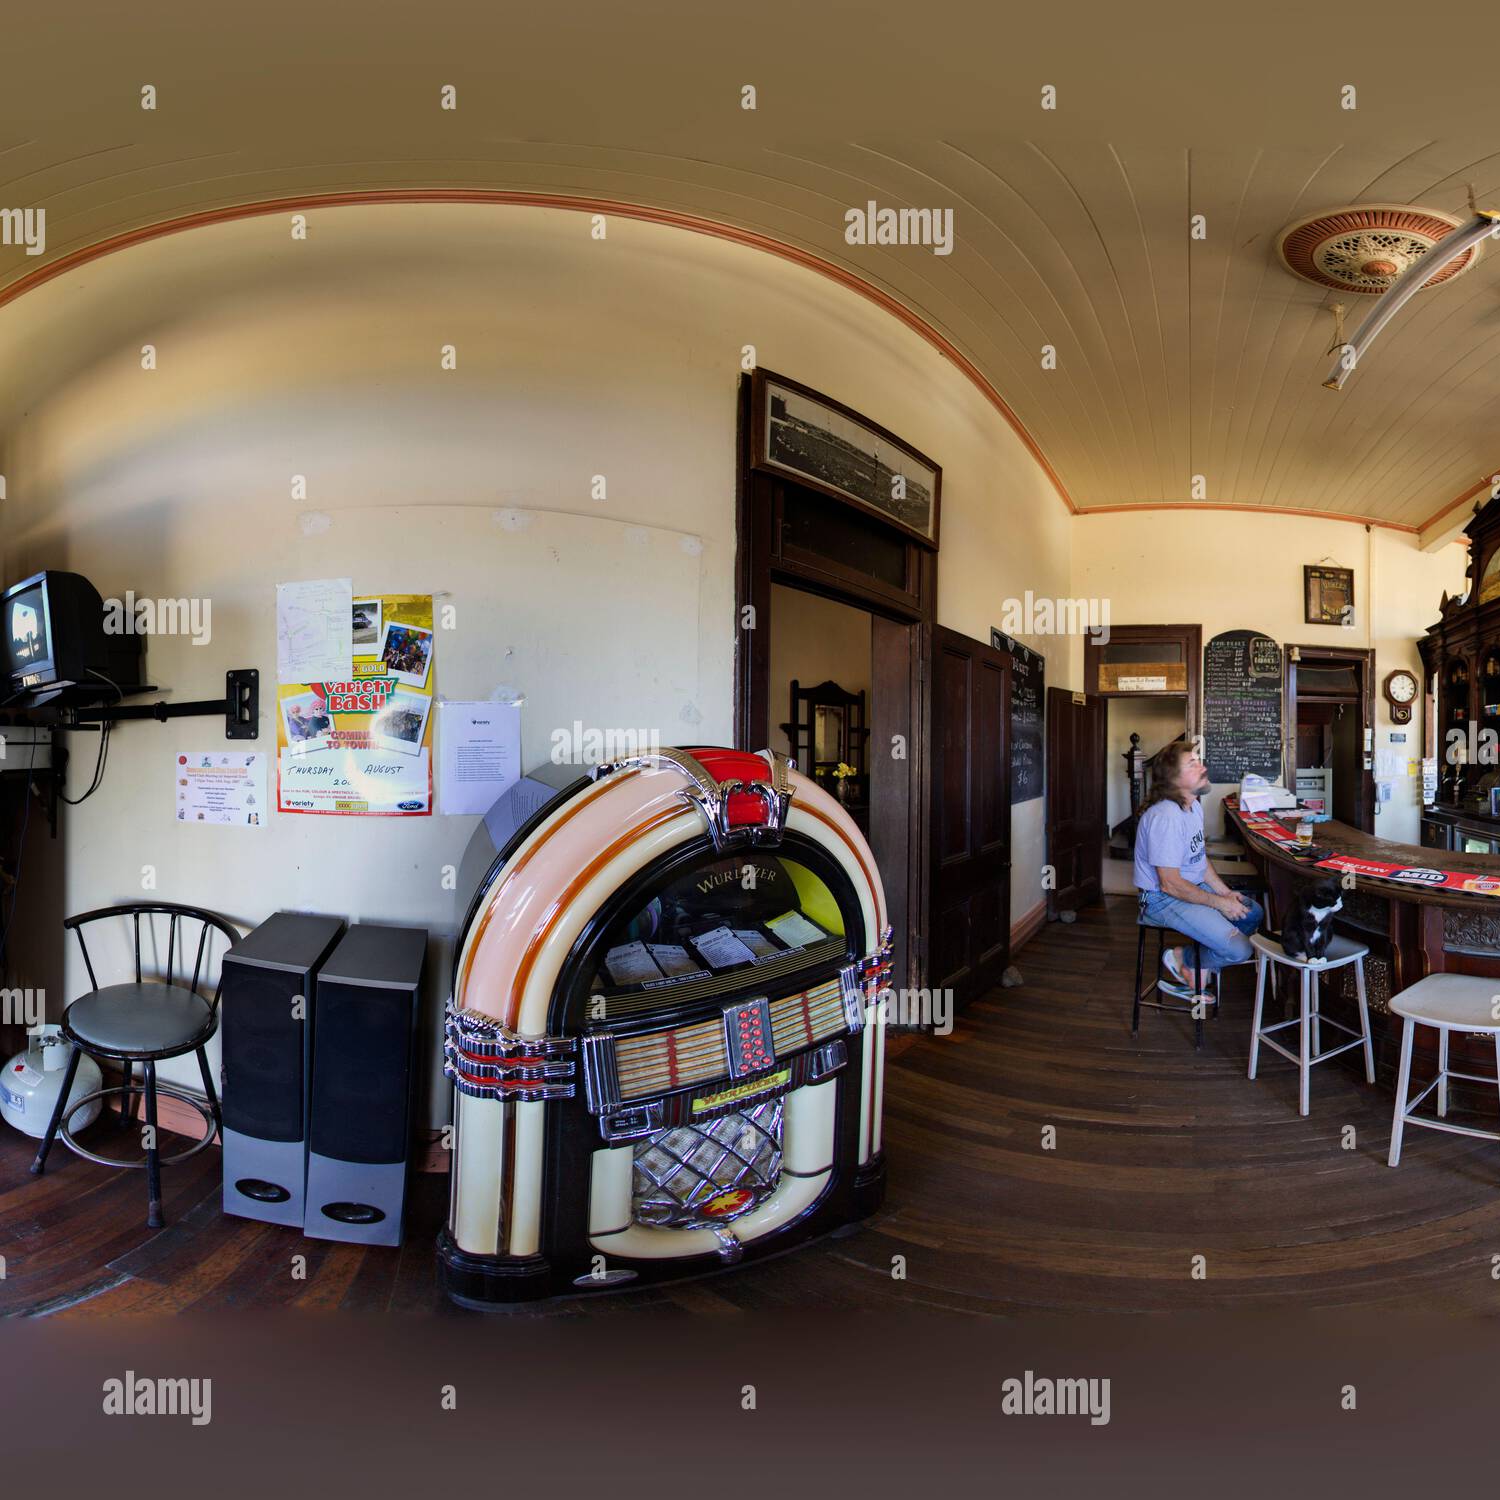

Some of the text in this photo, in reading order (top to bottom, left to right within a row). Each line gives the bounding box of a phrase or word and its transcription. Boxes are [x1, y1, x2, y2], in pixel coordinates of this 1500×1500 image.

[361, 663, 385, 673] GOLD
[287, 764, 404, 776] THURSDAY AUGUST
[292, 800, 314, 808] variety
[697, 865, 777, 894] WURLZER
[1396, 871, 1445, 881] MID
